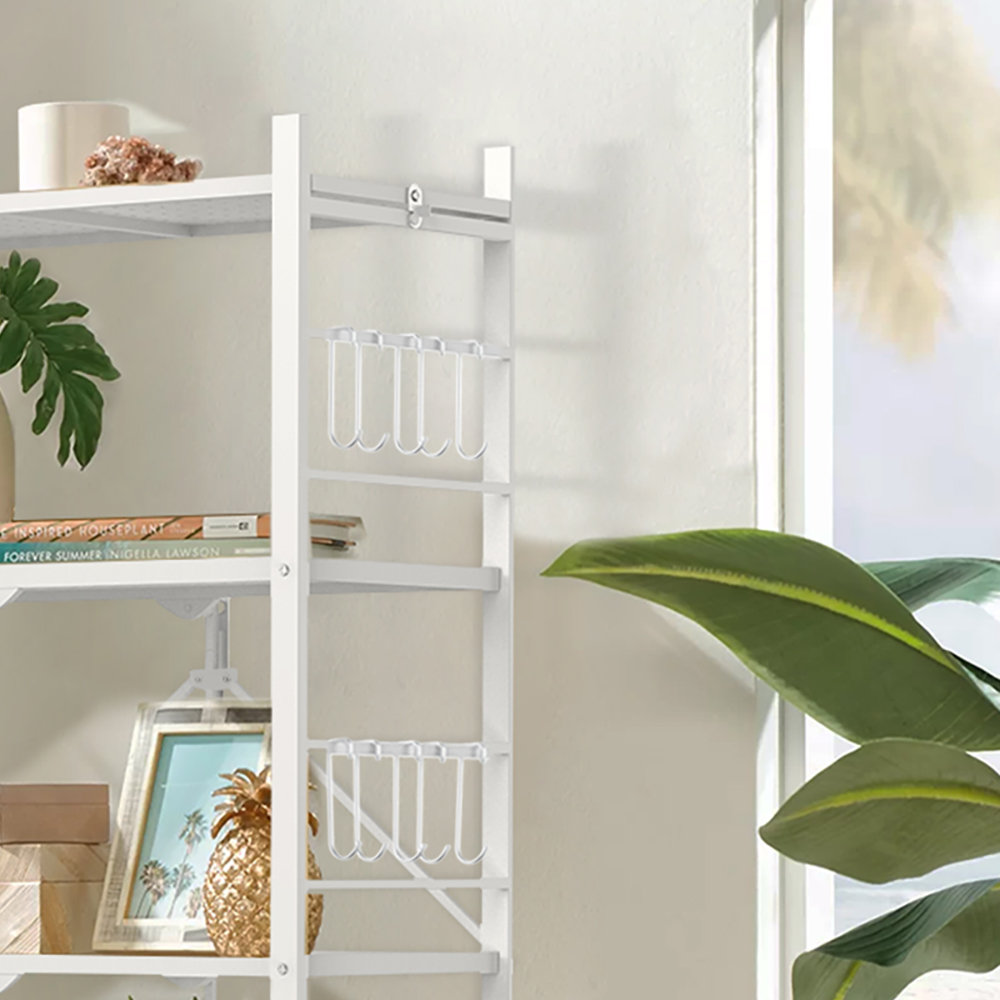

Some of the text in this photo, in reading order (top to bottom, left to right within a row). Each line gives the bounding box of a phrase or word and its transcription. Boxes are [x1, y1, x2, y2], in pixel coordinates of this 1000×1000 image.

[3, 550, 101, 562] FOREVER SUMMER
[108, 547, 161, 560] NIGELLA
[166, 546, 220, 559] LAWSON
